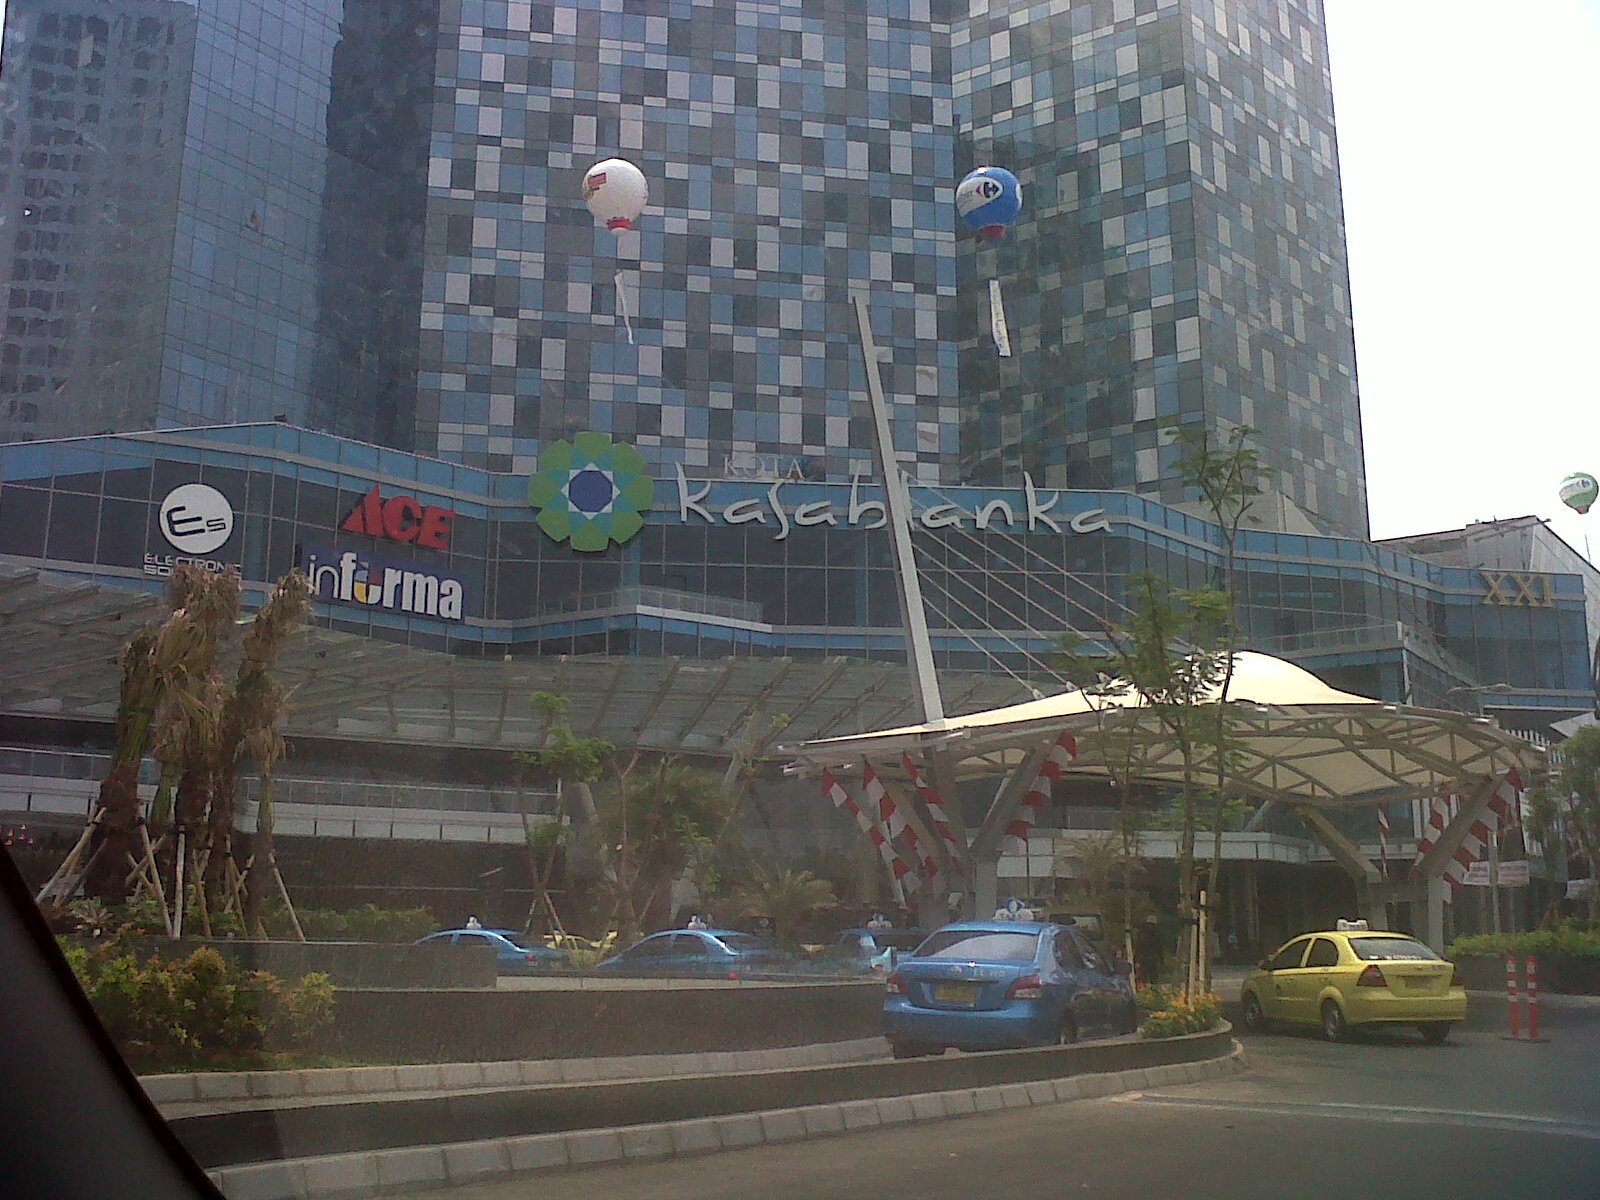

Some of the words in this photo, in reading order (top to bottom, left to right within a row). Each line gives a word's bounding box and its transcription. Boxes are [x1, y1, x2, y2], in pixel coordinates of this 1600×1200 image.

[724, 455, 805, 479] KOTA
[343, 482, 456, 549] ACE
[308, 552, 463, 620] informa
[1480, 571, 1555, 607] XXI
